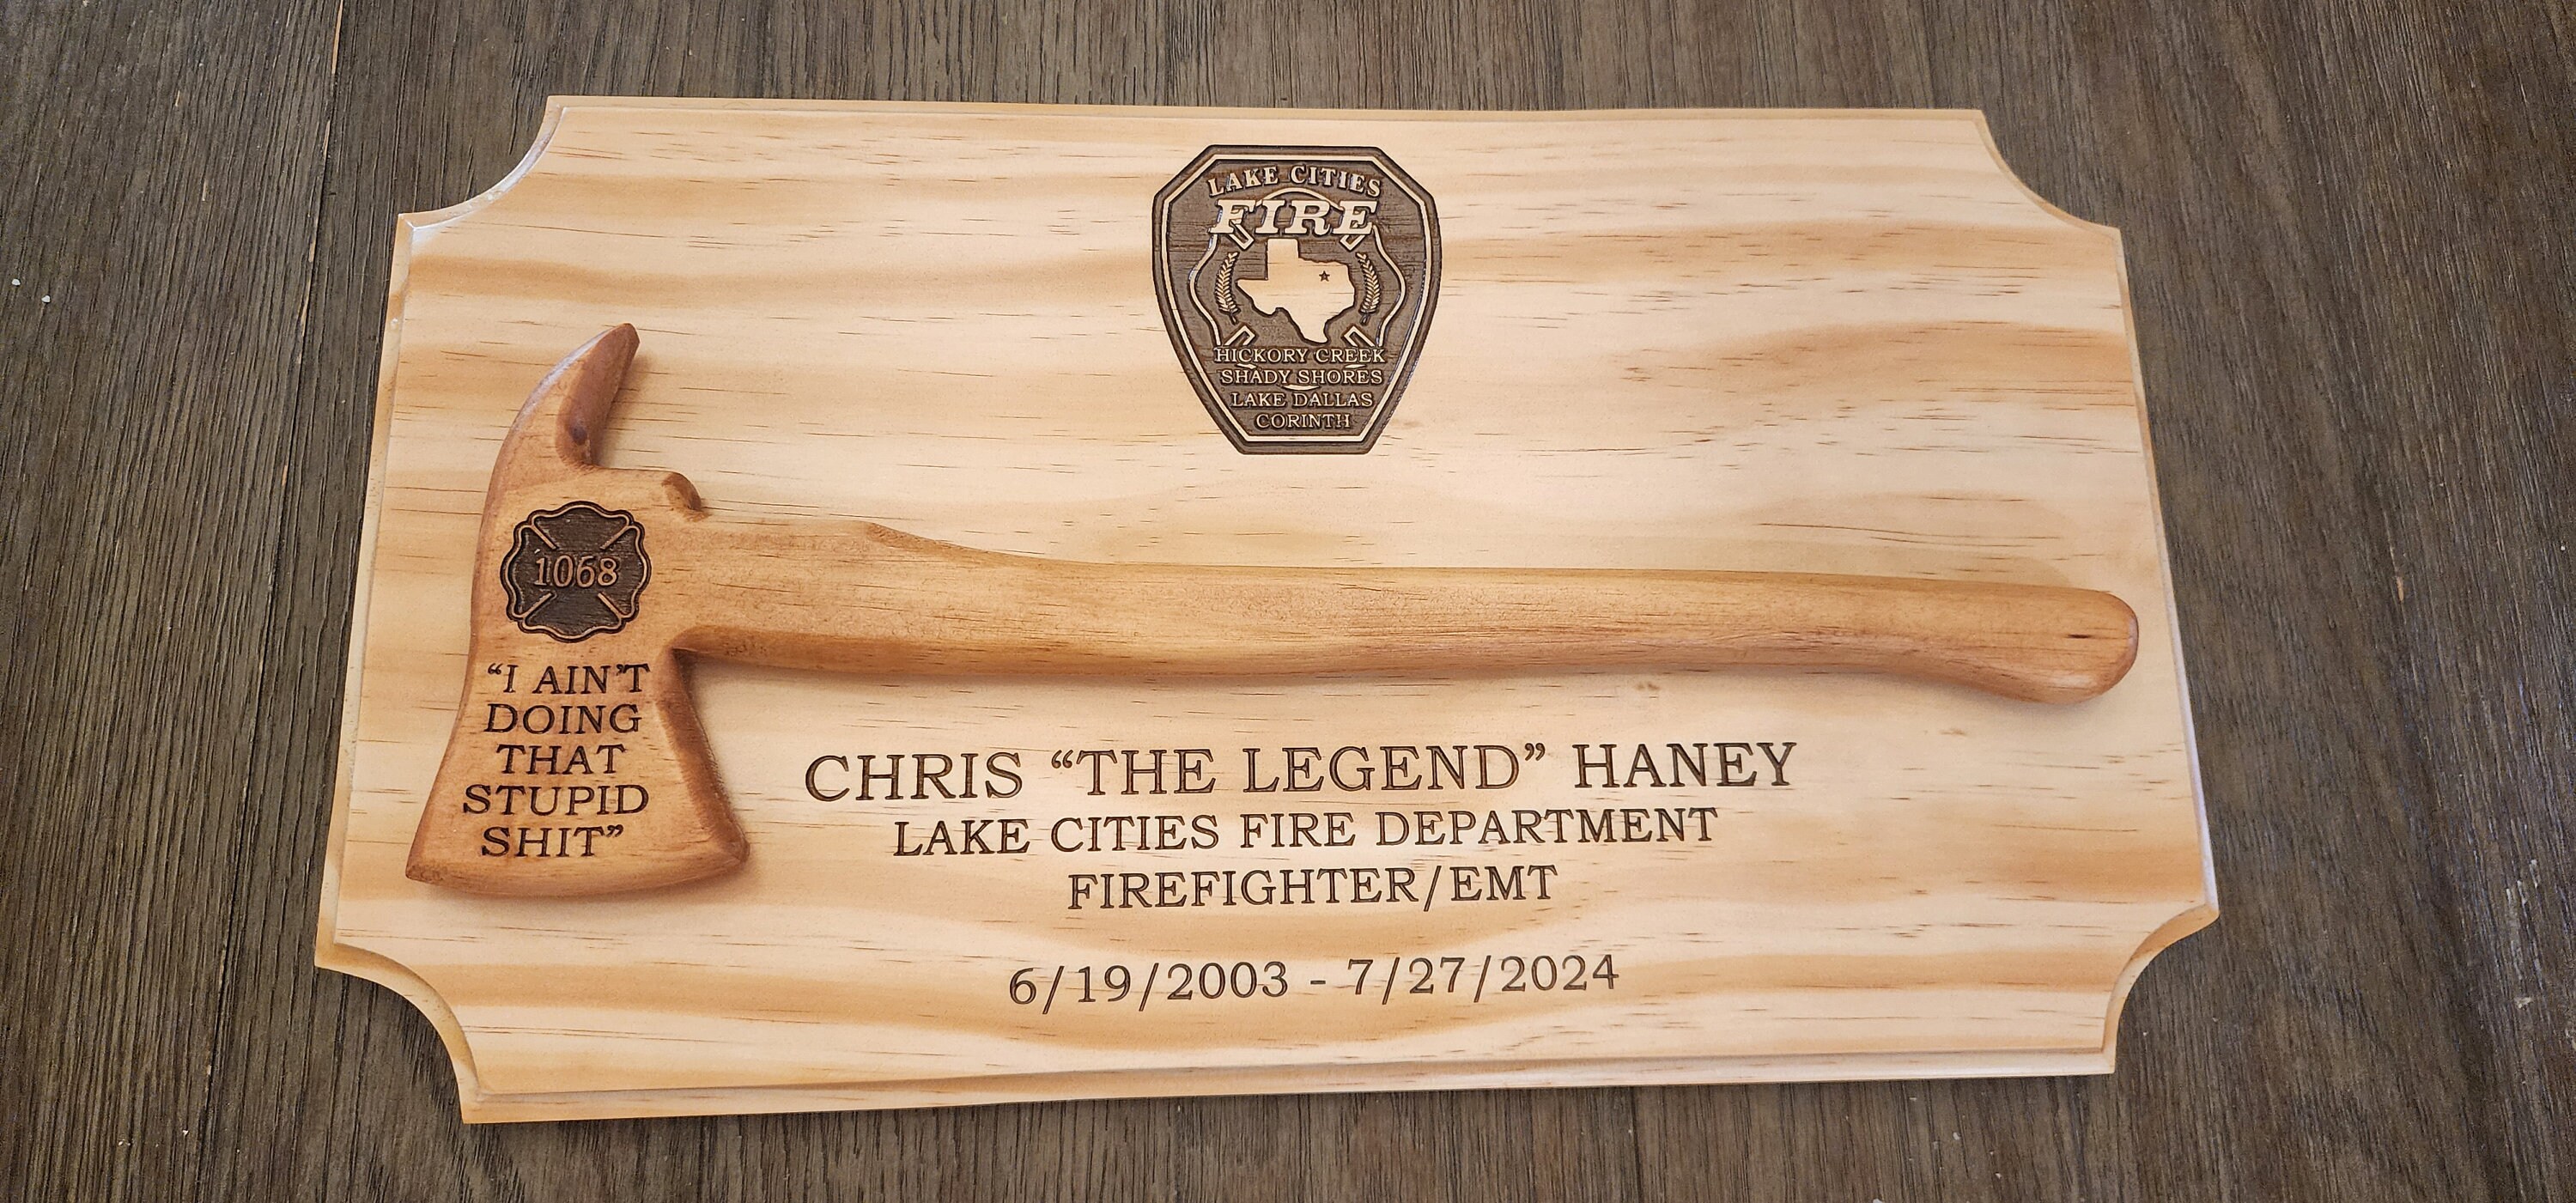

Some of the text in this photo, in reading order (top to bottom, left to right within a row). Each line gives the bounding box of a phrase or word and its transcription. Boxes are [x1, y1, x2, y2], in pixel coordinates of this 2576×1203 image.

[1207, 164, 1382, 197] LAKE CITIES
[1208, 198, 1378, 235] FIRE
[1214, 348, 1386, 363] HICKORY CREEK
[1220, 368, 1383, 385] SHADY SHORES
[1231, 392, 1373, 408] LAKE DALLAS
[1255, 413, 1351, 428] CORINTH
[534, 555, 620, 587] 1068
[487, 663, 651, 695] “I AIN’T
[483, 703, 642, 734] DOING
[496, 744, 627, 775] THAT
[805, 741, 1797, 802] CHRIS “THE LEGEND” HANEY
[462, 784, 650, 817] STUPID
[481, 824, 624, 857] SHIT”
[893, 806, 1717, 857] LAKE CITIES FIRE DEPARTMENT
[1067, 864, 1558, 911] FIREFIGHTER/EMT
[1008, 961, 1289, 1015] 6/19/2003
[1347, 954, 1619, 1006] 7/27/2024
